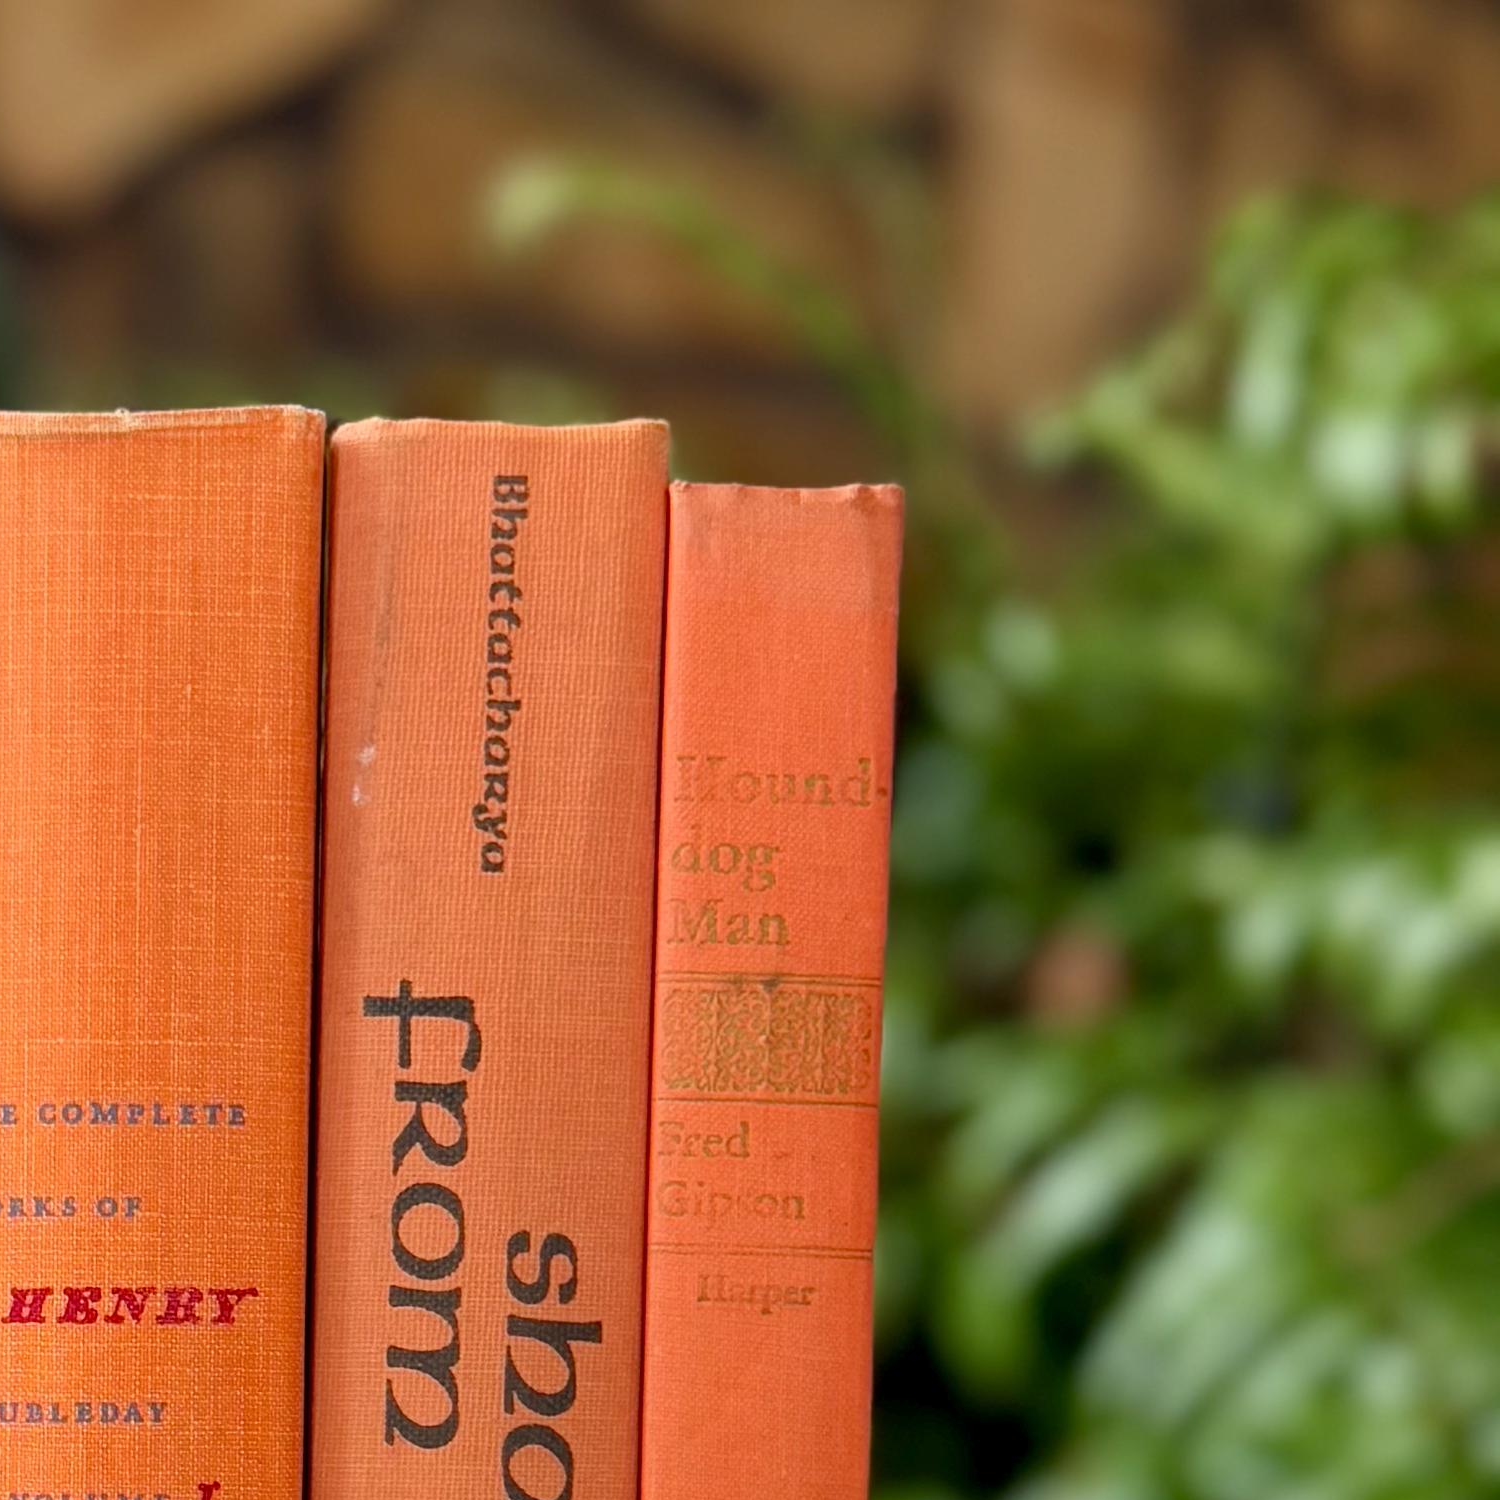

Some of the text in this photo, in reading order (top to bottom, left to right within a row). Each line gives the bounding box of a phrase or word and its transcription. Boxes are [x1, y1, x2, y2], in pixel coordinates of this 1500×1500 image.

[472, 474, 529, 874] Bhattacharya
[671, 824, 780, 892] dog
[666, 898, 792, 946] Man
[38, 1102, 247, 1126] COMPLETE
[658, 1120, 750, 1159] Fred
[95, 1196, 143, 1218] OF
[0, 1285, 259, 1326] HENRY
